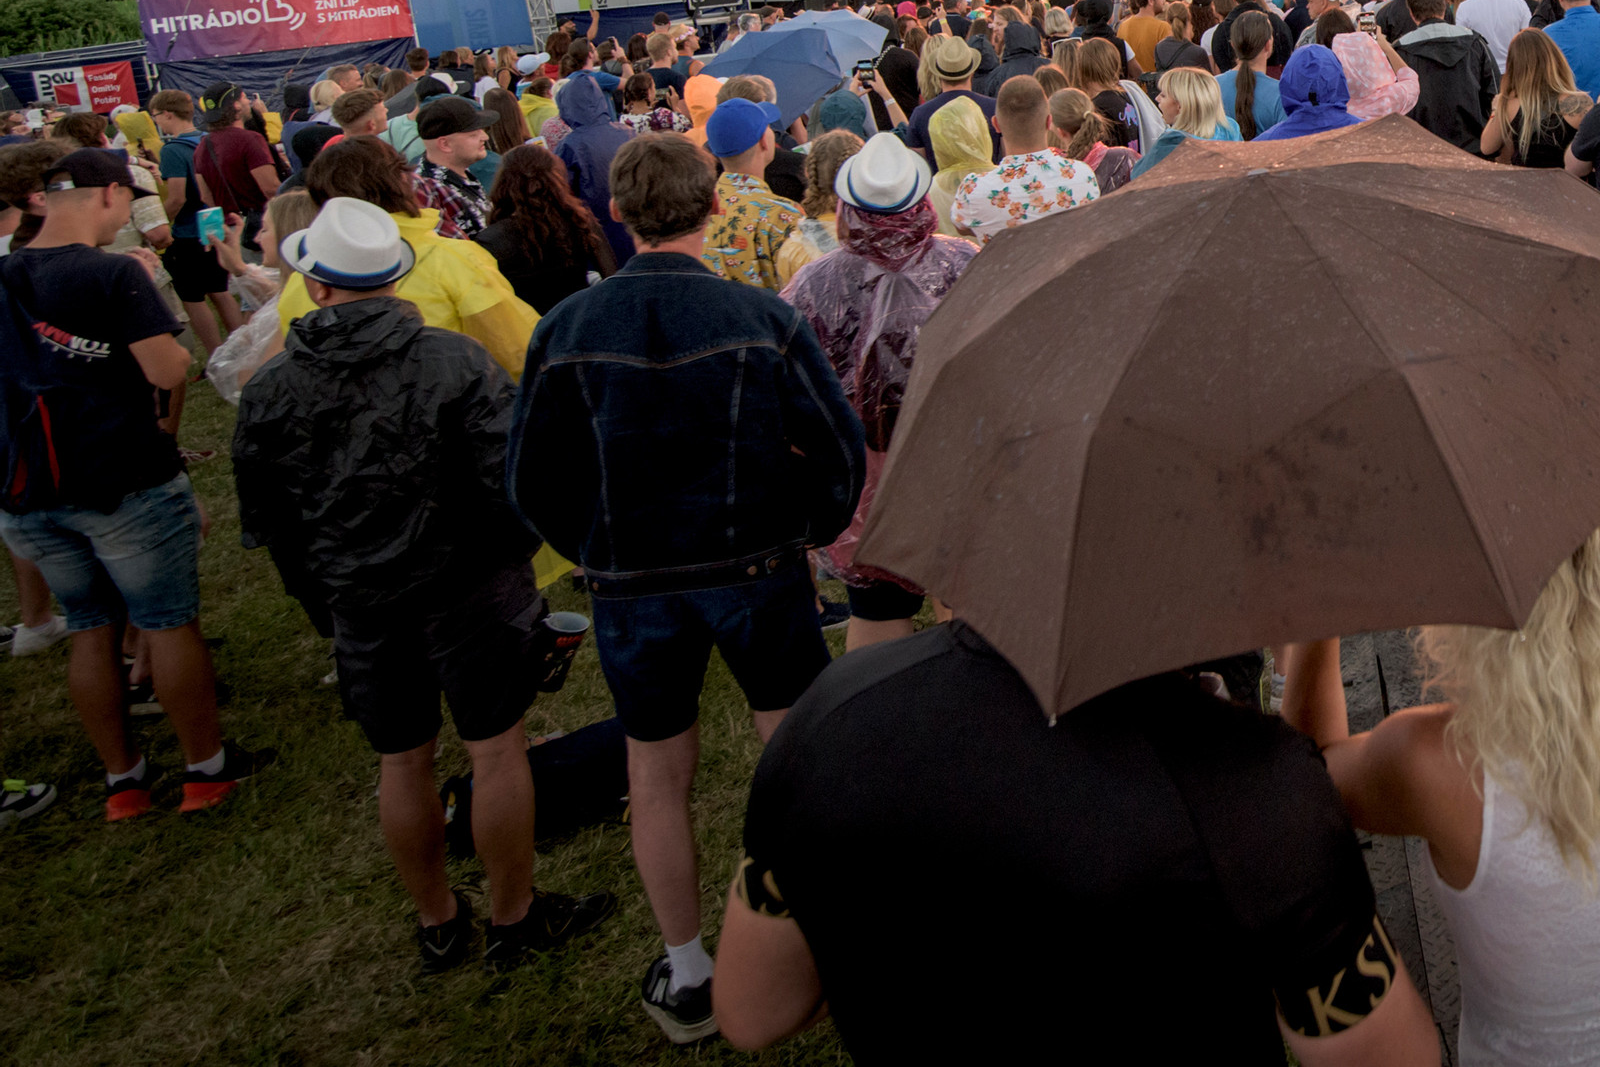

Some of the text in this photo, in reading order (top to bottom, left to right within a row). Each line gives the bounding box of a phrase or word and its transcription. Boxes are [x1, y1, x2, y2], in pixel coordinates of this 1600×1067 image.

[151, 7, 262, 34] HITRÁDIO
[317, 4, 400, 24] S HITRÁDIEM
[88, 72, 118, 82] Fasády
